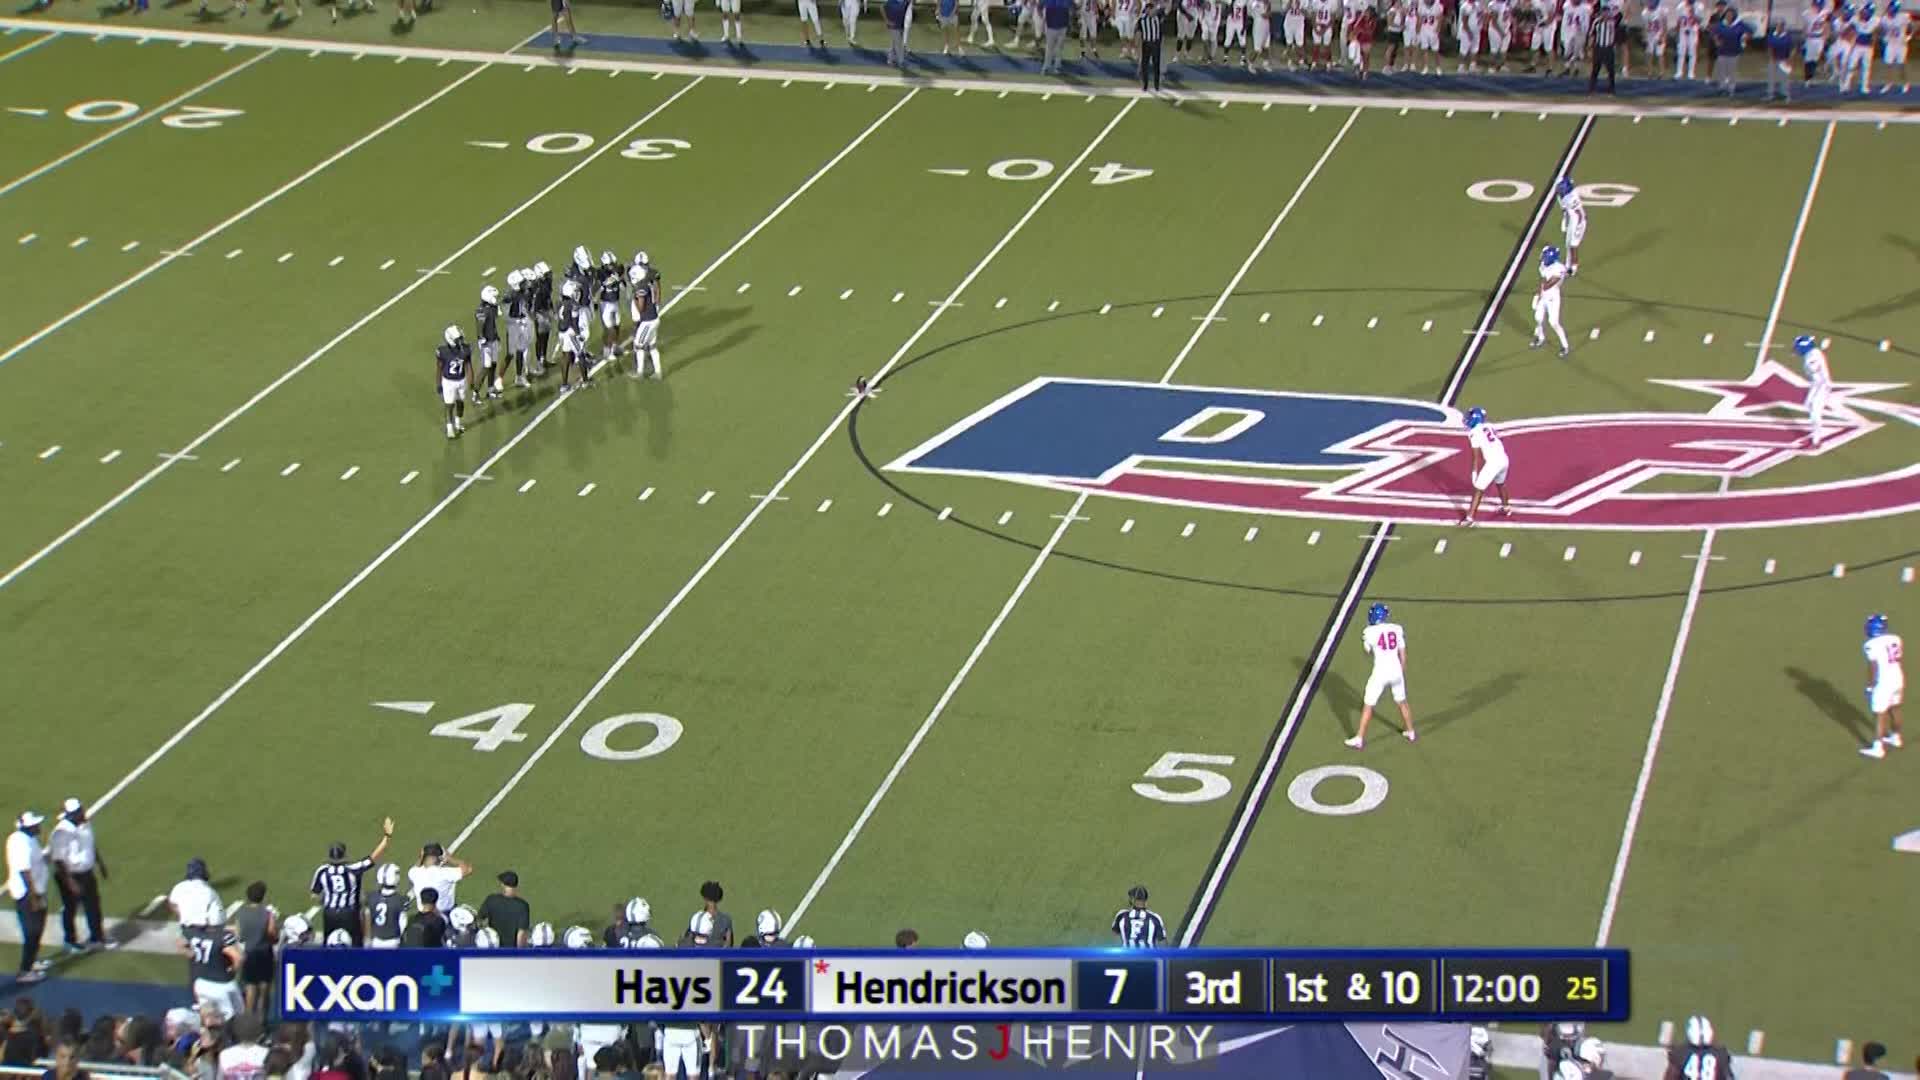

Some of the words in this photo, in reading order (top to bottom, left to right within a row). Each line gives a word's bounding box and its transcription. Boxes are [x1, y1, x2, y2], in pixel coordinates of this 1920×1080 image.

[449, 358, 465, 374] 27
[1377, 631, 1398, 650] 48
[375, 902, 389, 927] 3
[1130, 918, 1145, 939] F
[1683, 1053, 1717, 1080] 48
